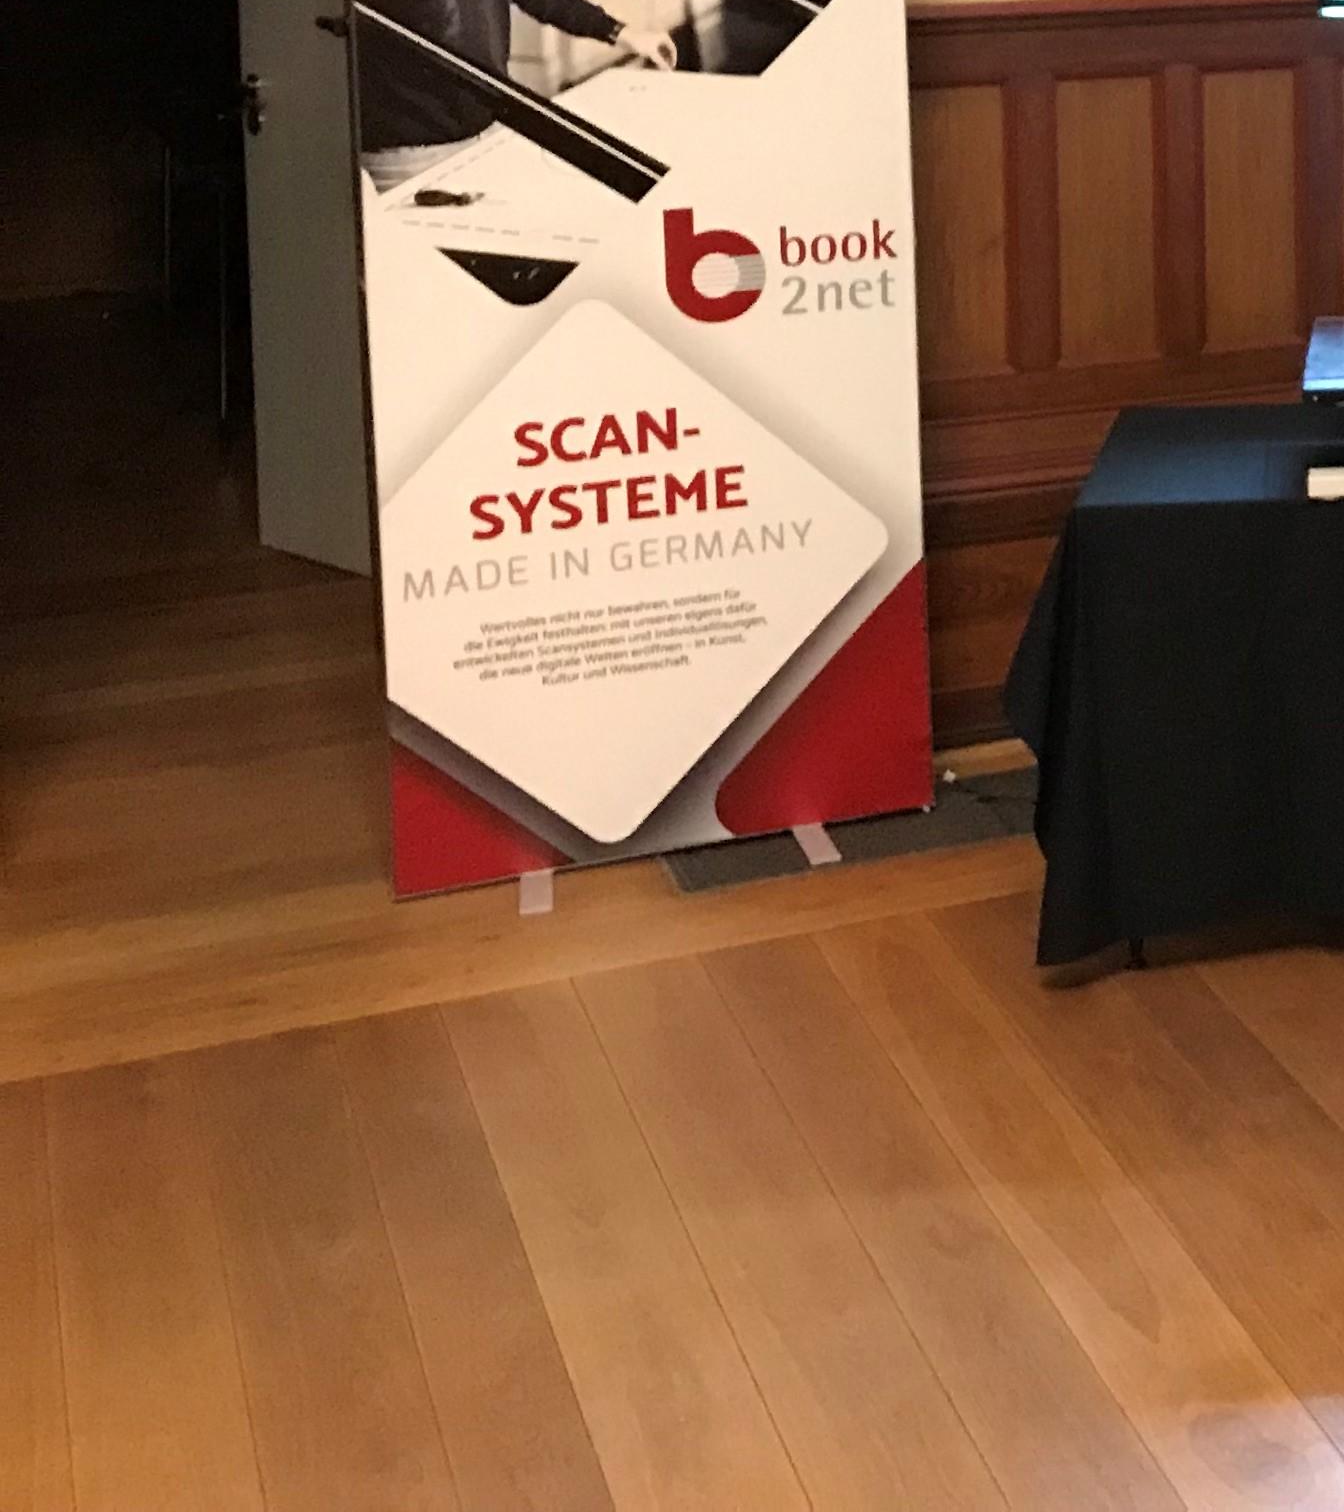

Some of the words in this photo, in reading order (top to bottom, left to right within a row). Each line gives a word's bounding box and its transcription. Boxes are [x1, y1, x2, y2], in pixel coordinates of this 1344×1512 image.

[780, 219, 898, 267] book
[782, 270, 896, 315] 2net
[514, 407, 700, 467] SCAN-
[469, 465, 748, 541] SYSTEME
[402, 555, 528, 602] MADE
[550, 547, 589, 581] IN
[610, 518, 814, 572] GERMANY
[464, 640, 483, 652] die
[487, 631, 538, 650] Ewigkeit
[610, 619, 630, 631] mit
[633, 611, 683, 628] unseren
[685, 607, 723, 623] eigens
[725, 599, 757, 615] dafür
[480, 615, 546, 635] Wertvolles
[550, 610, 580, 625] nicht
[584, 607, 603, 620] nur
[608, 598, 669, 617] bewahren,
[673, 589, 721, 607] sondern
[724, 587, 740, 600] für
[453, 650, 534, 670] entwickelten
[537, 633, 626, 656] Scansystemen
[628, 628, 651, 642] und
[480, 668, 498, 681] die
[501, 664, 533, 676] neue
[537, 656, 581, 675] digitale
[585, 650, 628, 665] Welten
[631, 641, 683, 659] eröffnen
[695, 638, 705, 648] in
[542, 671, 580, 686] Kultur
[583, 666, 607, 680] und
